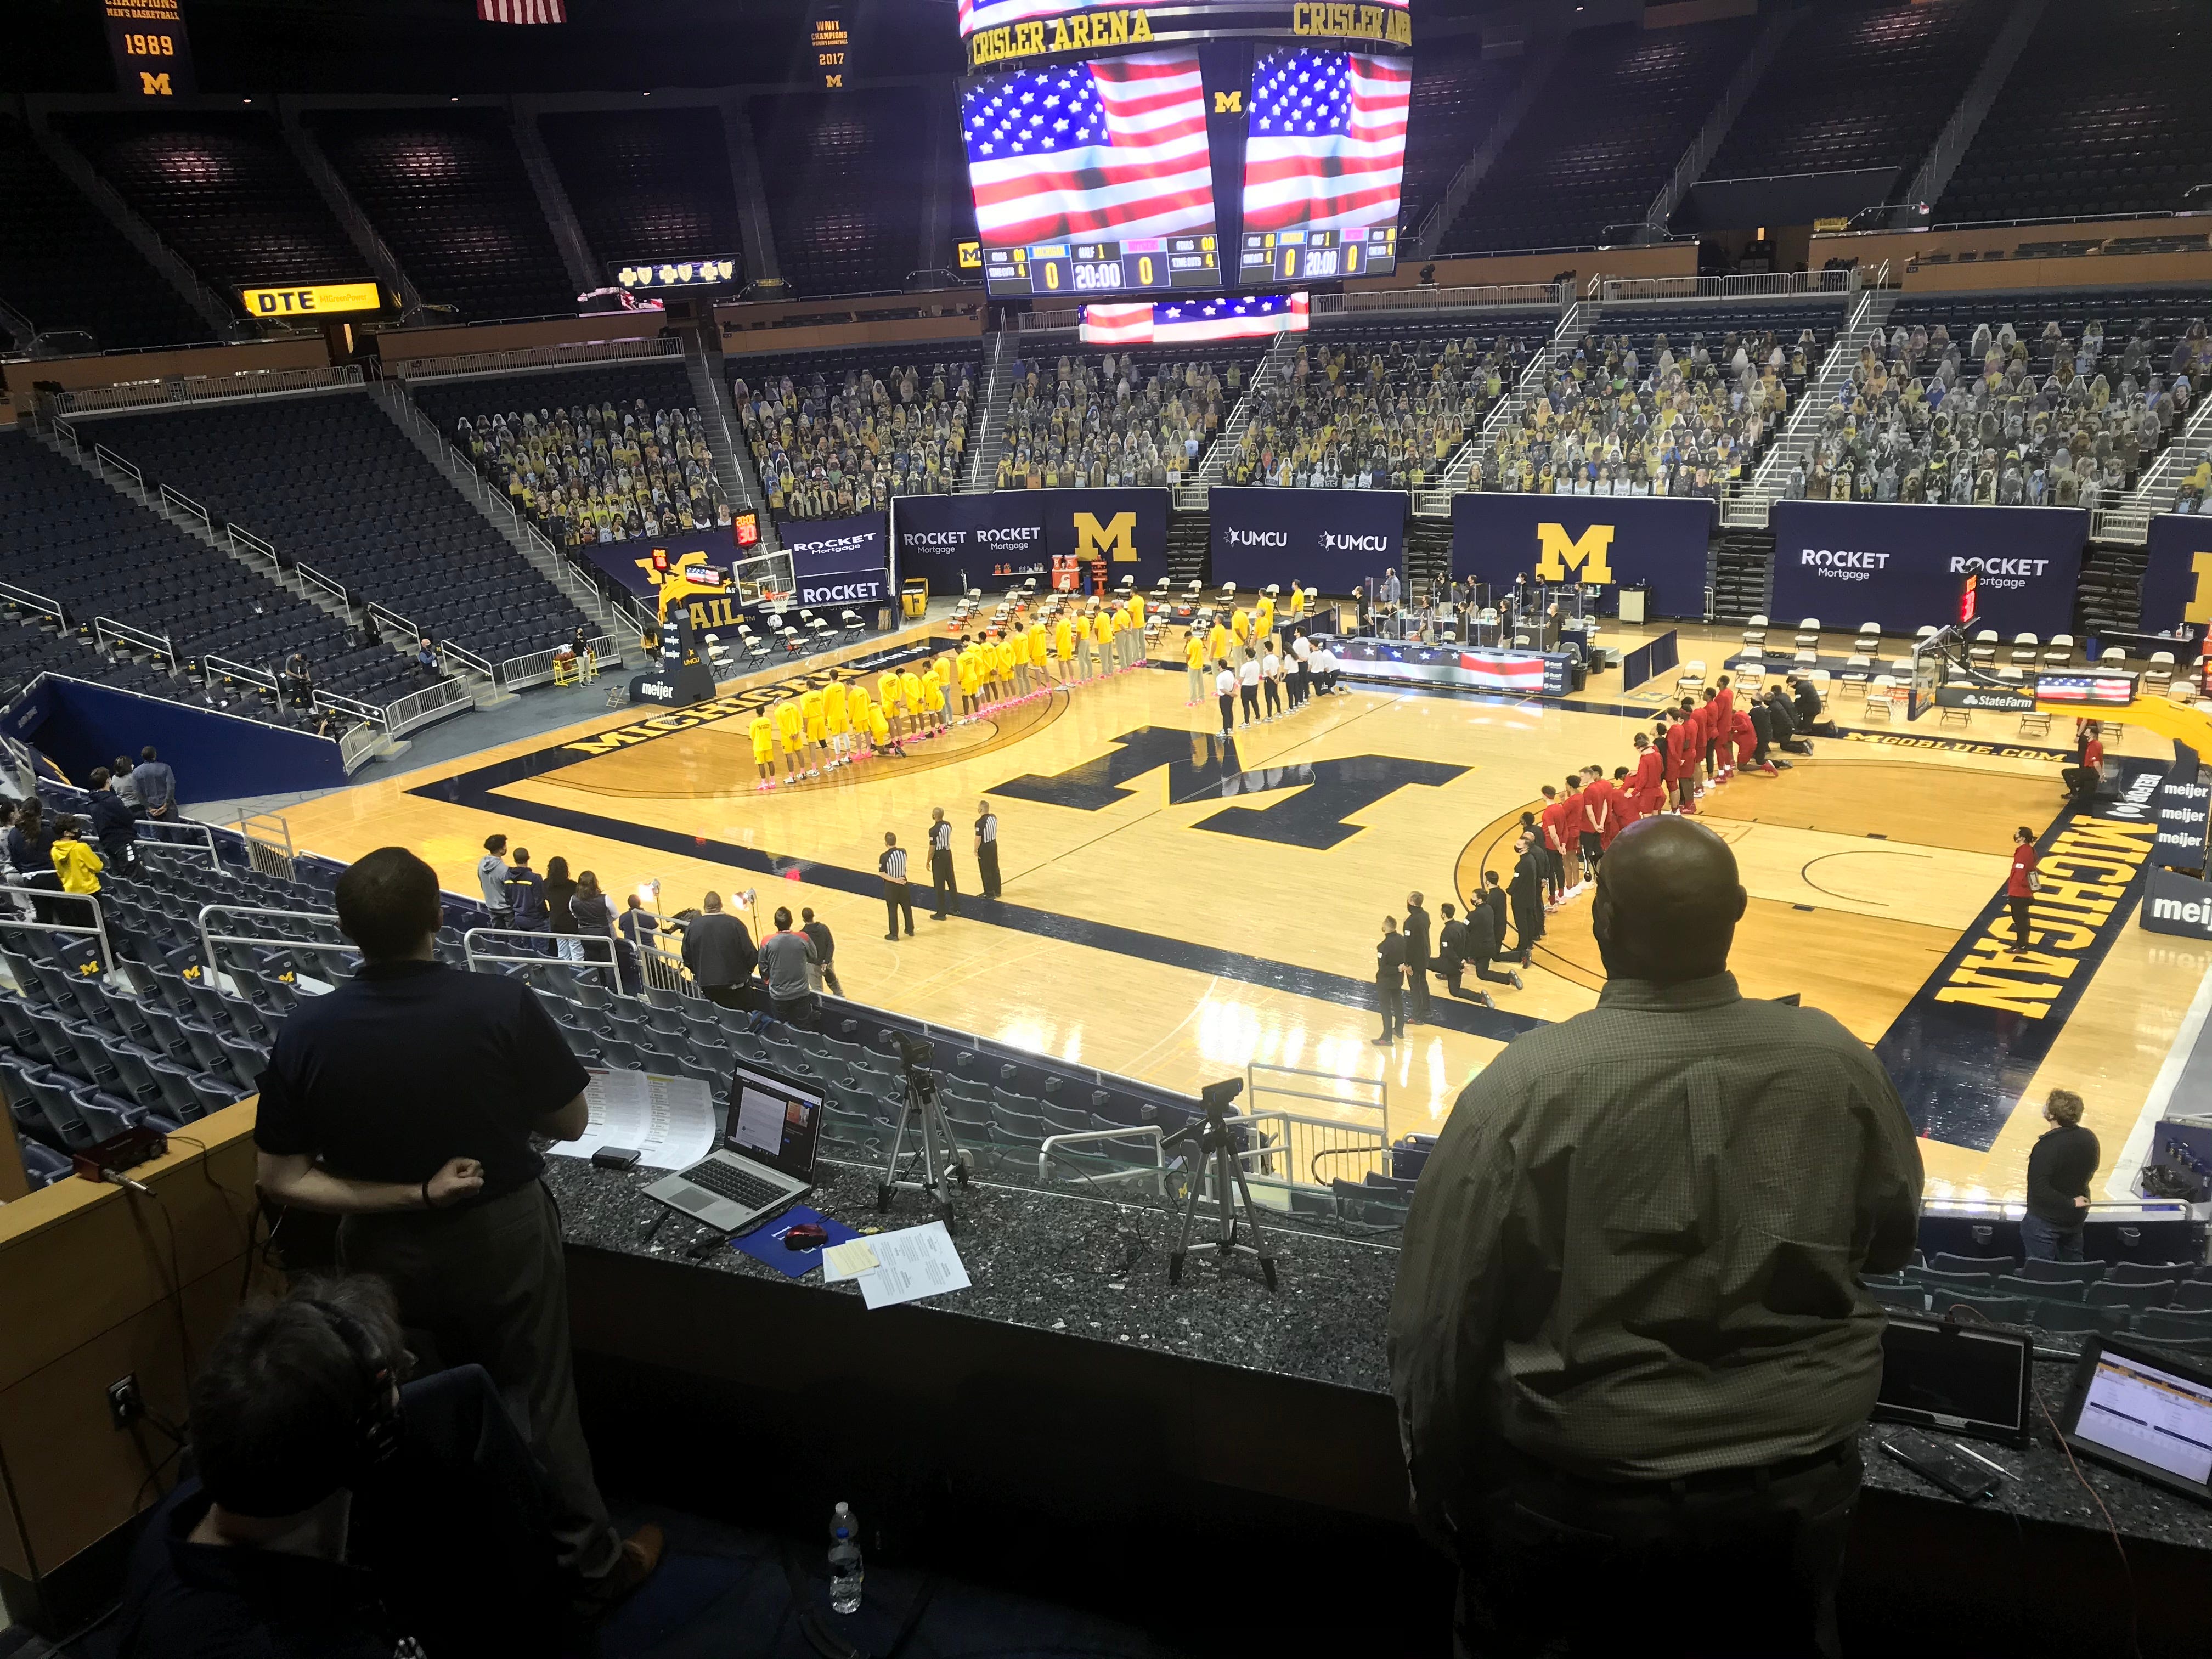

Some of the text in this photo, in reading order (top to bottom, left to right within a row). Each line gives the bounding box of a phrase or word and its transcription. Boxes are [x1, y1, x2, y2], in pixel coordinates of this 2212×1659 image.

[106, 8, 180, 20] MEN'S BASKETBALL
[1294, 2, 1383, 39] CRISLER
[816, 20, 839, 31] WNIT
[811, 31, 848, 40] CHAMPIONS
[972, 8, 1154, 65] CRISLER ARENA
[125, 34, 174, 55] 1989
[819, 53, 844, 65] 2017
[140, 72, 173, 95] M
[826, 74, 843, 87] M
[1214, 91, 1242, 113] M
[1201, 236, 1215, 251] 00
[1324, 232, 1330, 246] 1
[962, 247, 981, 262] M
[1013, 248, 1025, 262] 00
[1079, 244, 1105, 259] HALF 1
[1266, 250, 1272, 264] 4
[1387, 243, 1393, 256] 4
[1206, 253, 1214, 267] 4
[1285, 249, 1296, 276] 0
[1306, 250, 1338, 276] 20:00
[1347, 245, 1358, 272] 0
[1018, 264, 1025, 277] 4
[1045, 262, 1059, 289] 0
[1075, 263, 1121, 289] 20:00
[1139, 256, 1153, 285] 0
[258, 291, 315, 313] DTE
[1123, 476, 1133, 486] 88
[736, 513, 756, 527] 20:00
[736, 524, 757, 544] 30
[793, 532, 876, 552] ROCKET
[904, 531, 967, 546] ROCKET
[977, 527, 1041, 543] ROCKET
[1074, 512, 1137, 562] M
[1242, 531, 1288, 547] UMCU
[812, 544, 861, 555] Mortgage
[917, 546, 955, 554] Mortgage
[991, 541, 1029, 551] Mortgage
[1337, 534, 1387, 552] UMCU
[1536, 522, 1615, 584] M
[1802, 549, 1890, 569] ROCKET
[1818, 567, 1870, 582] Mortgage
[1980, 578, 2026, 589] ortgage
[803, 582, 879, 603] ROCKET
[689, 597, 744, 630] AIL
[663, 622, 678, 631] meijer
[664, 636, 679, 645] meijer
[665, 650, 680, 659] meijer
[684, 657, 700, 665] UMCU
[855, 653, 908, 668] BELFOR
[642, 681, 674, 701] meijer
[561, 665, 870, 755] MICHIGAN
[1842, 731, 2068, 762] MGOBLUE.COM
[988, 725, 1475, 851] M
[2125, 773, 2163, 804] BELFOR
[2164, 783, 2209, 799] meijer
[2162, 808, 2205, 823] meijer
[2158, 832, 2203, 848] meijer
[1934, 814, 2158, 1020] MICHIGAN
[80, 960, 99, 976] M
[182, 965, 201, 979] M
[278, 971, 294, 983] M
